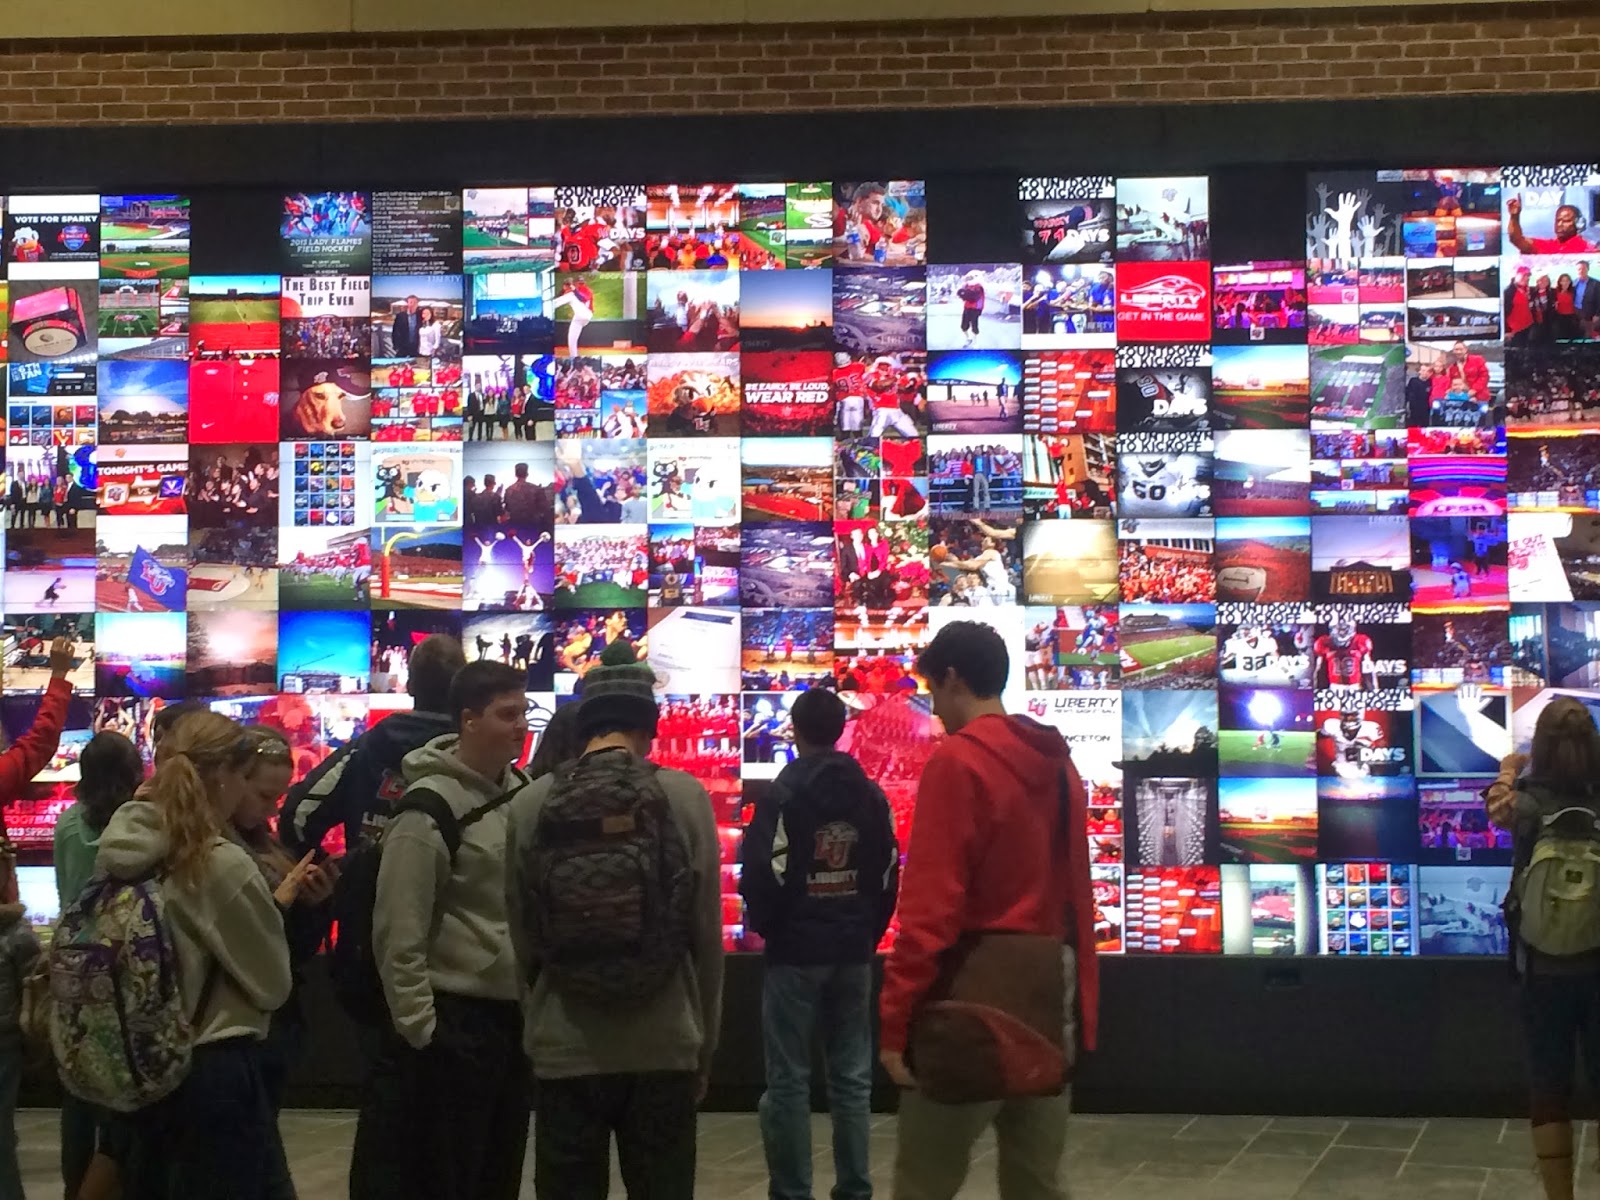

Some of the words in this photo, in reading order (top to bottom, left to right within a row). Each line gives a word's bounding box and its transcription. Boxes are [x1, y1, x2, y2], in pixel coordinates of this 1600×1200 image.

[1501, 176, 1521, 188] TO
[1526, 173, 1588, 188] KICKOFF
[554, 184, 647, 197] COUNTDOWN
[1044, 186, 1103, 200] KICKOFF
[554, 196, 573, 207] TO
[578, 195, 636, 207] KICKOFF
[14, 215, 39, 224] VOTE
[40, 215, 60, 223] FOR
[61, 214, 98, 223] SPARKY
[609, 227, 646, 239] DAYS
[1066, 228, 1110, 243] DAYS
[331, 238, 363, 246] FLAMES
[321, 245, 355, 253] HOCKEY
[284, 278, 304, 291] THE
[309, 278, 336, 291] BEST
[341, 278, 370, 290] FIELD
[329, 293, 354, 306] EVER
[1117, 312, 1139, 321] GET
[1140, 312, 1152, 321] IN
[1153, 312, 1174, 321] THE
[1175, 312, 1206, 321] GAME
[803, 383, 830, 391] LOUD,
[746, 391, 794, 403] WEAR
[795, 391, 829, 403] RED
[97, 465, 155, 475] TONIGHT'S
[157, 463, 189, 472] GAME
[1362, 659, 1407, 674] DAYS
[1055, 698, 1118, 708] LIBERTY
[1360, 747, 1406, 762] DAYS
[3, 800, 76, 814] LIBERT
[4, 815, 57, 824] FOOTBAL
